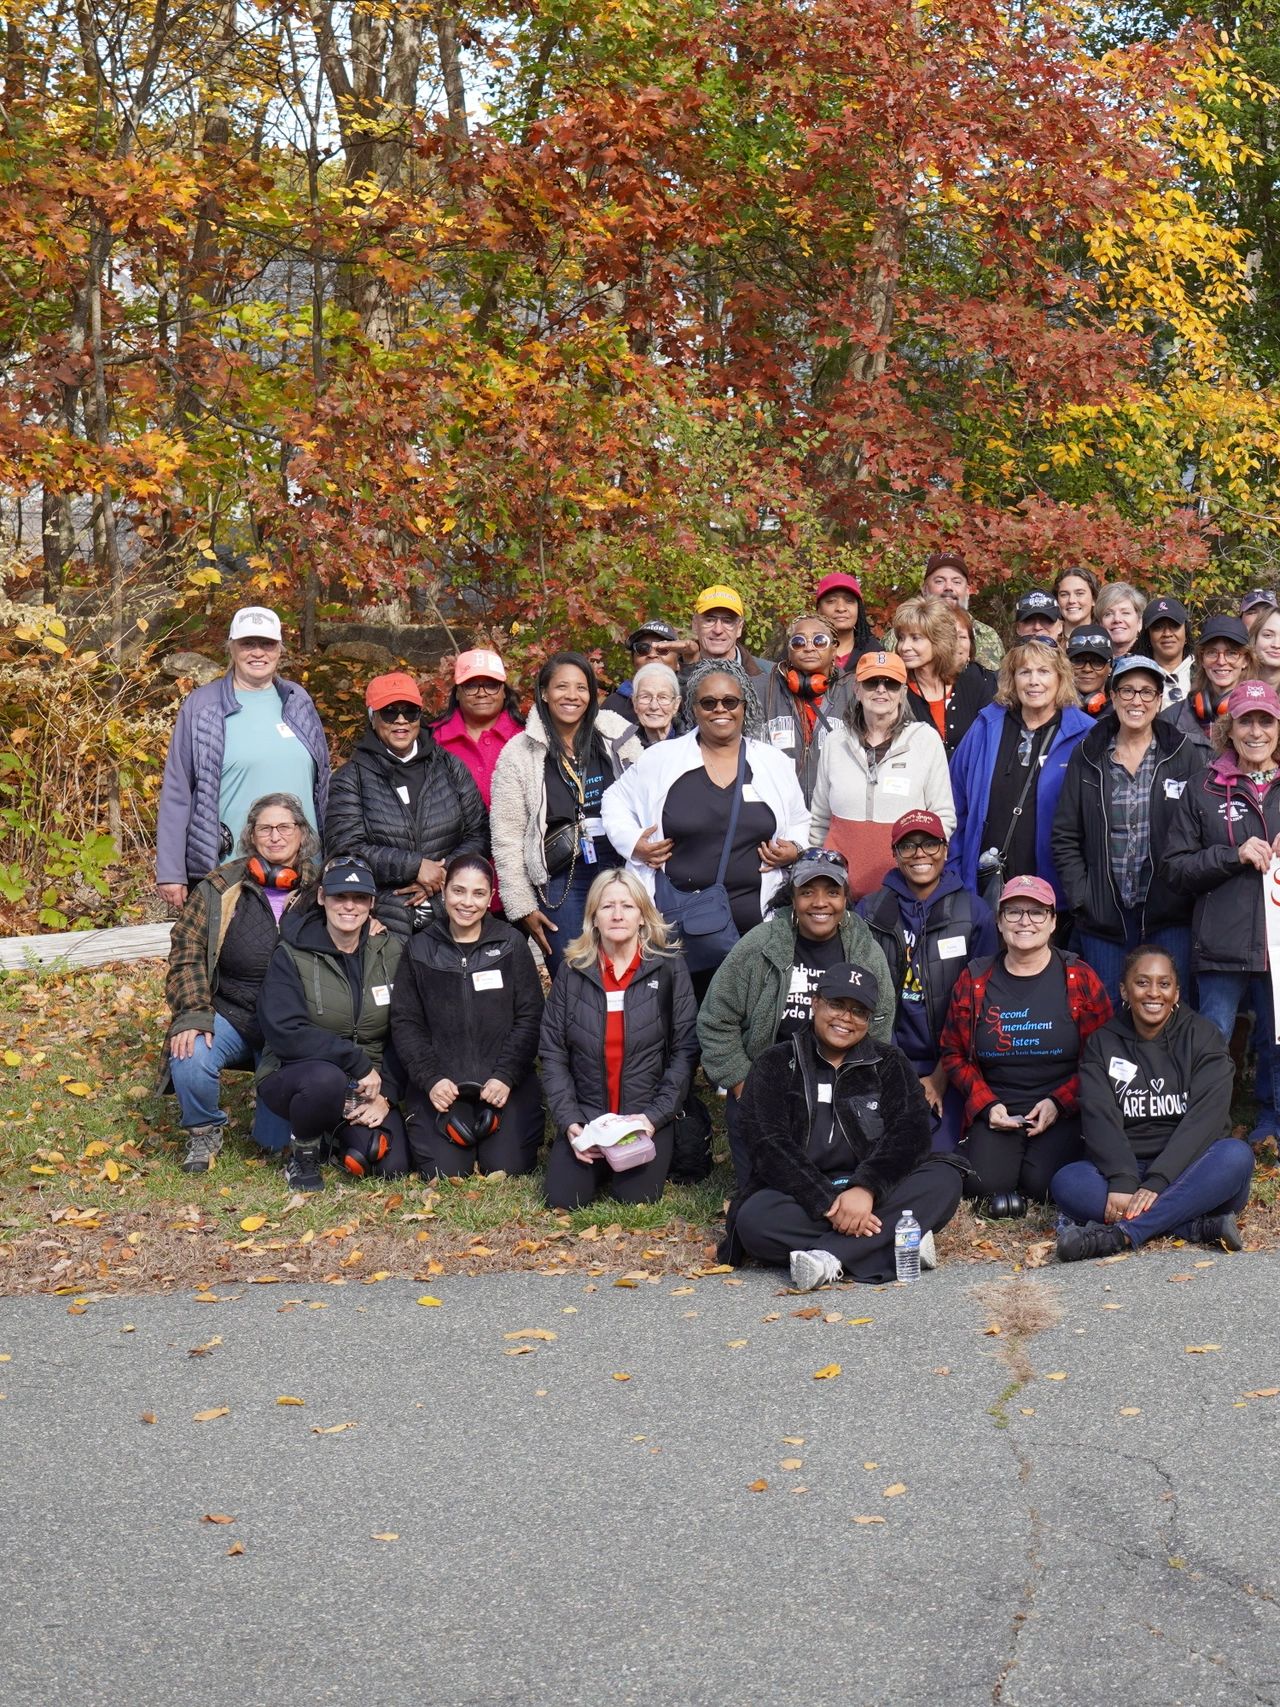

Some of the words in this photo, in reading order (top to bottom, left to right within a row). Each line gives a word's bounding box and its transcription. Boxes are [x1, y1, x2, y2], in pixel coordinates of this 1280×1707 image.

[849, 971, 862, 986] K
[781, 1006, 806, 1020] yde
[985, 1006, 1030, 1024] Second
[988, 1021, 1052, 1036] Amendment
[995, 1033, 1040, 1051] Sisters
[1123, 1097, 1146, 1117] ARE
[1149, 1091, 1188, 1117] ENOU
